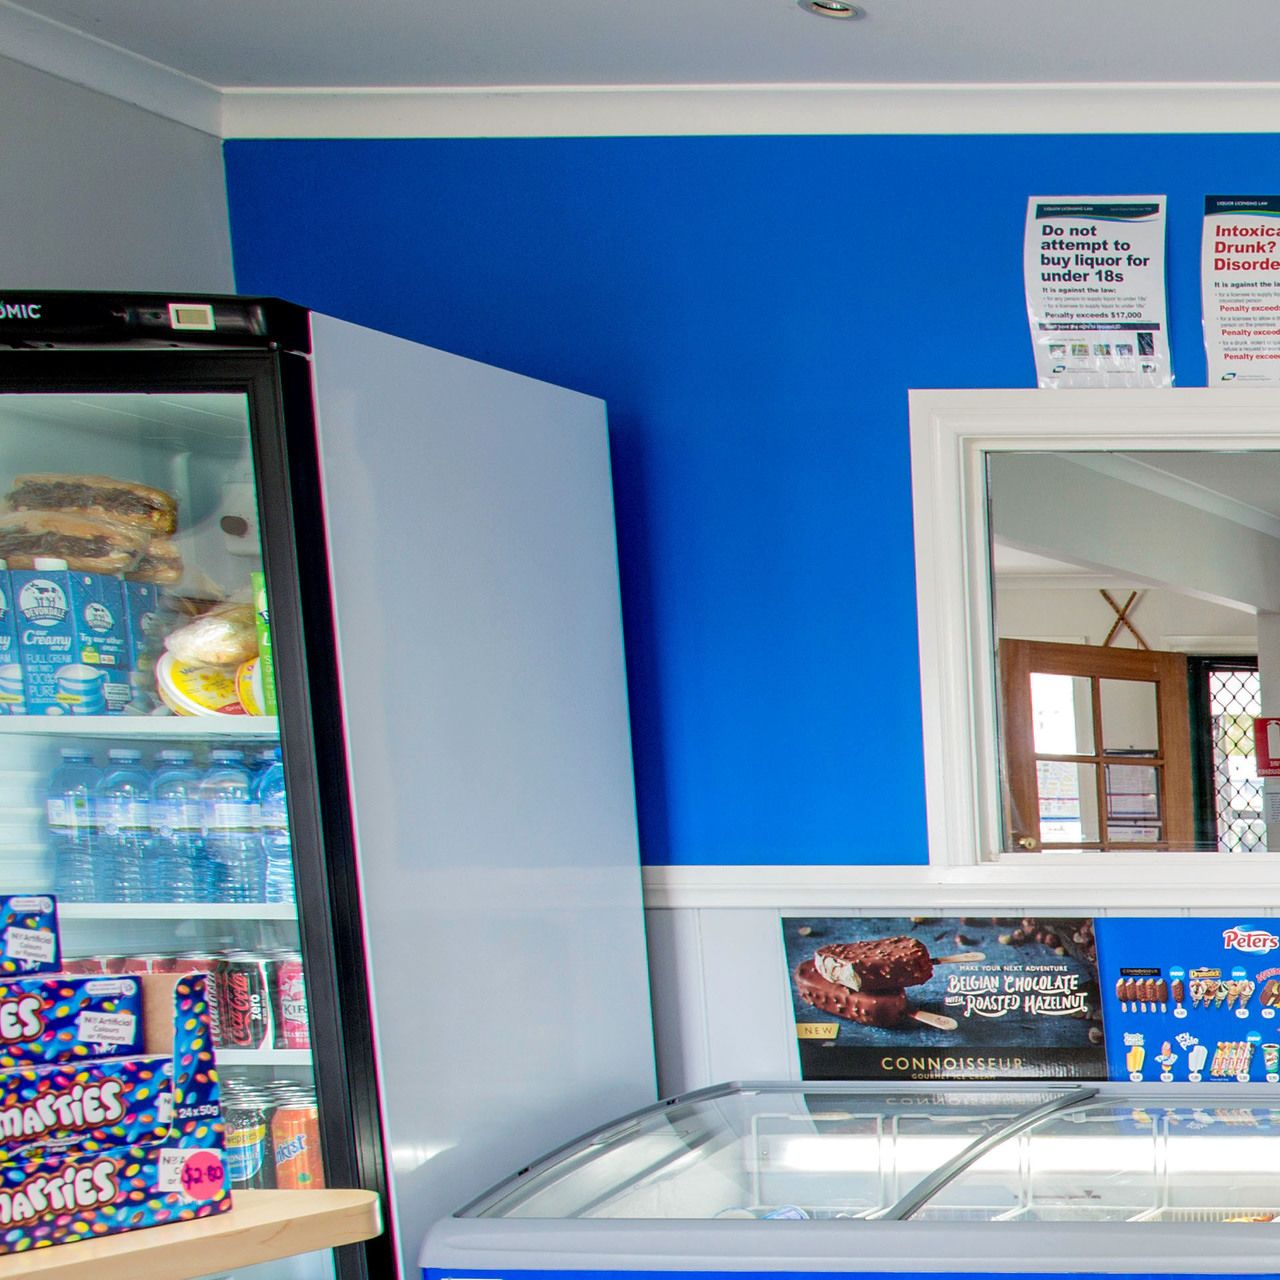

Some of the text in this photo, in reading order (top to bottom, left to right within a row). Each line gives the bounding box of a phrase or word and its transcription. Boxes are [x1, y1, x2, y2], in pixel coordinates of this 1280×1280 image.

[1042, 225, 1097, 236] Do not
[1041, 240, 1130, 253] attempt to
[1215, 241, 1277, 253] Drunk?
[1041, 254, 1150, 268] buy liquor for
[1041, 270, 1124, 282] under 18s
[1045, 312, 1074, 320] Penalty
[1111, 311, 1142, 319] $17,000
[1222, 329, 1251, 337] Penalty
[1224, 353, 1253, 361] Penalty
[23, 631, 71, 650] Creamy
[1224, 931, 1278, 949] Peters
[947, 975, 1079, 994] BELGIAN CHOCOLATE
[249, 994, 261, 1020] zero
[964, 995, 1020, 1017] ROASTED
[1025, 993, 1088, 1015] HAZELNUT
[804, 1025, 833, 1036] NEW
[881, 1056, 1023, 1071] CONNOISSEUR
